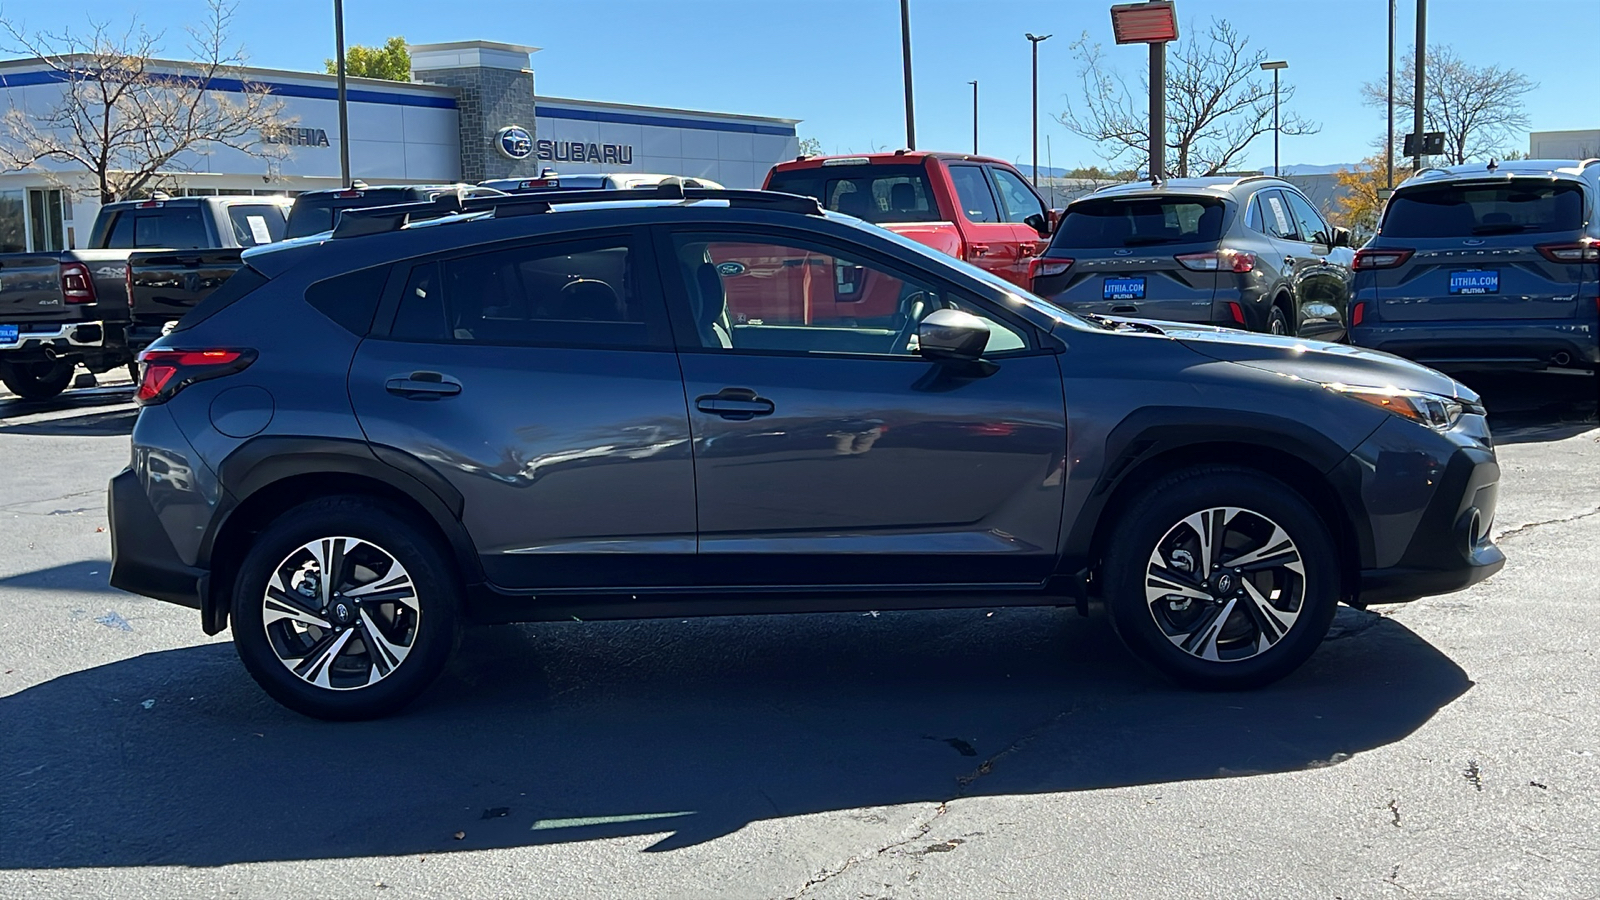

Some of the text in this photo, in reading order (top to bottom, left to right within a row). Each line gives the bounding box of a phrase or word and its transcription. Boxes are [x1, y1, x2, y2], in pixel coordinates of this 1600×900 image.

[537, 139, 633, 165] SUBARU
[1450, 276, 1498, 287] LITHIA.COM
[1104, 283, 1145, 293] LITHIA.COM
